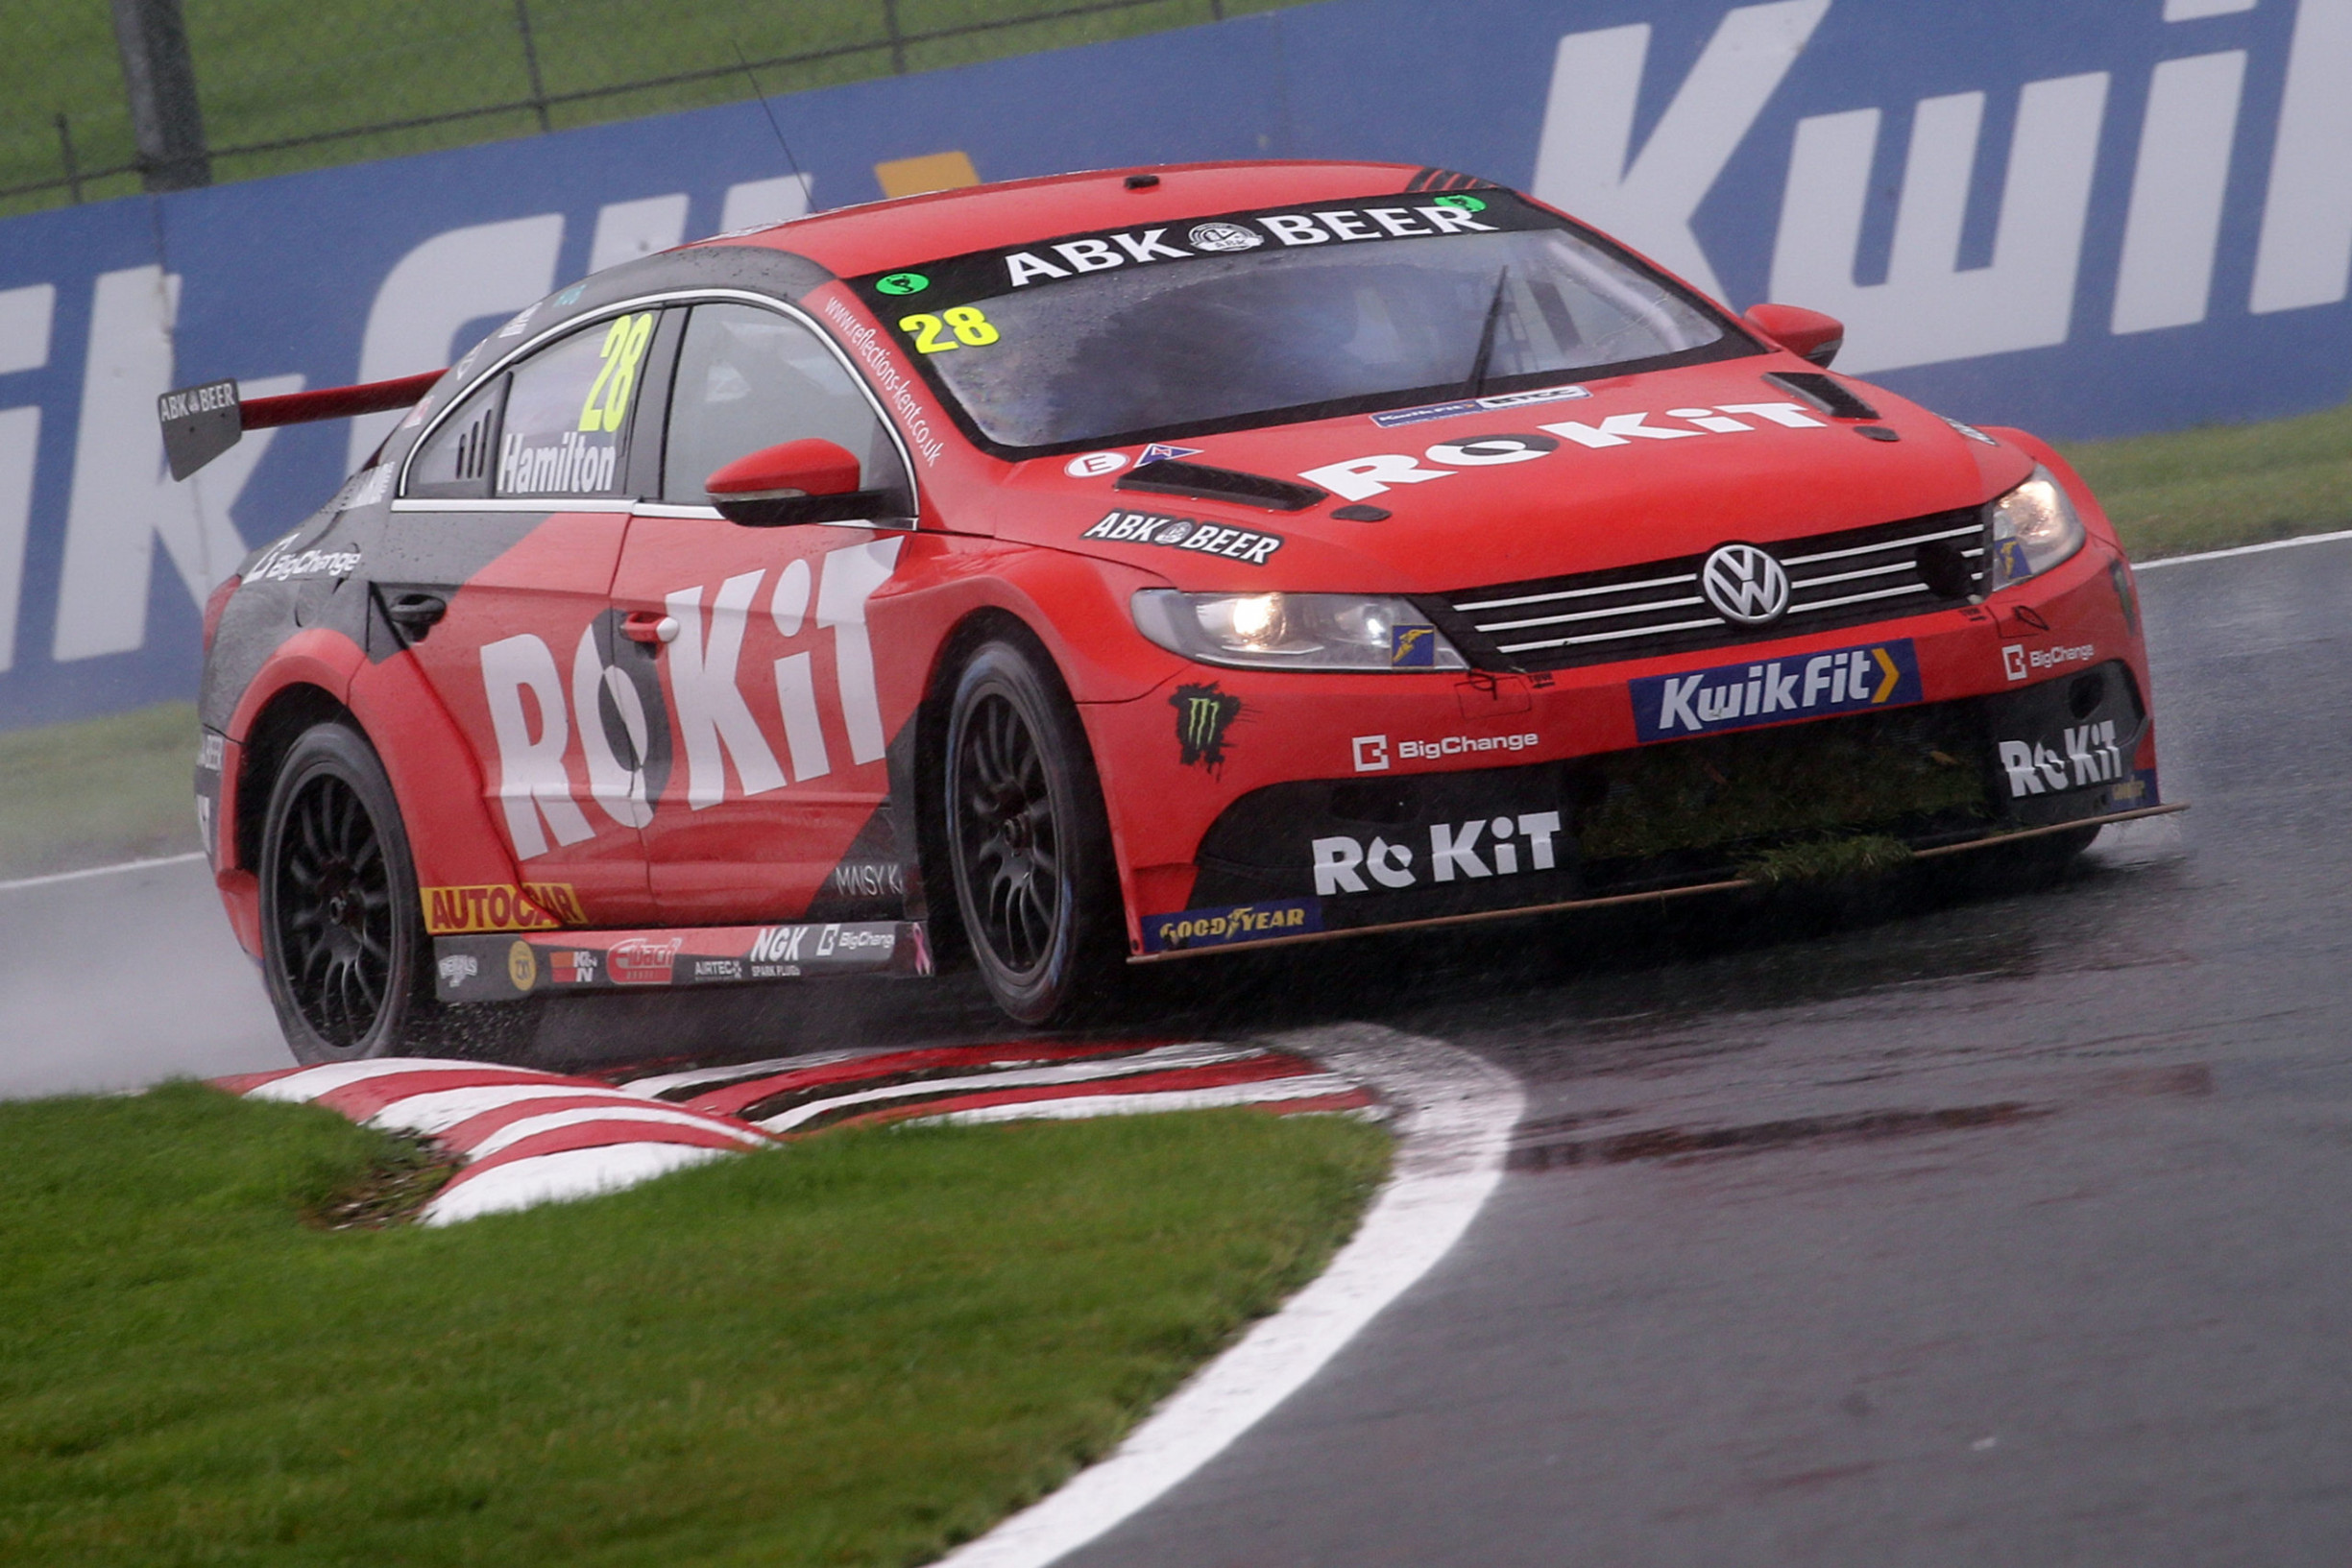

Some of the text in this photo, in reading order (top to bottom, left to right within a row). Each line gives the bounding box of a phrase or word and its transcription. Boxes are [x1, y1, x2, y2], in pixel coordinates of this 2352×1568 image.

[1005, 205, 1500, 288] ABK BEER
[897, 306, 1000, 354] 28
[578, 312, 653, 433] 28
[824, 296, 945, 468] www.reflections-kent.co.uk
[160, 383, 235, 422] ABK BEER
[497, 431, 617, 495] Hamilton
[1084, 512, 1280, 564] ABK BEER
[265, 549, 362, 582] BigChange
[2029, 644, 2095, 668] BigChange
[1398, 731, 1539, 760] BigChange
[432, 883, 584, 929] AUTOCAR
[750, 927, 810, 962] NGK
[751, 965, 776, 977] SPARK
